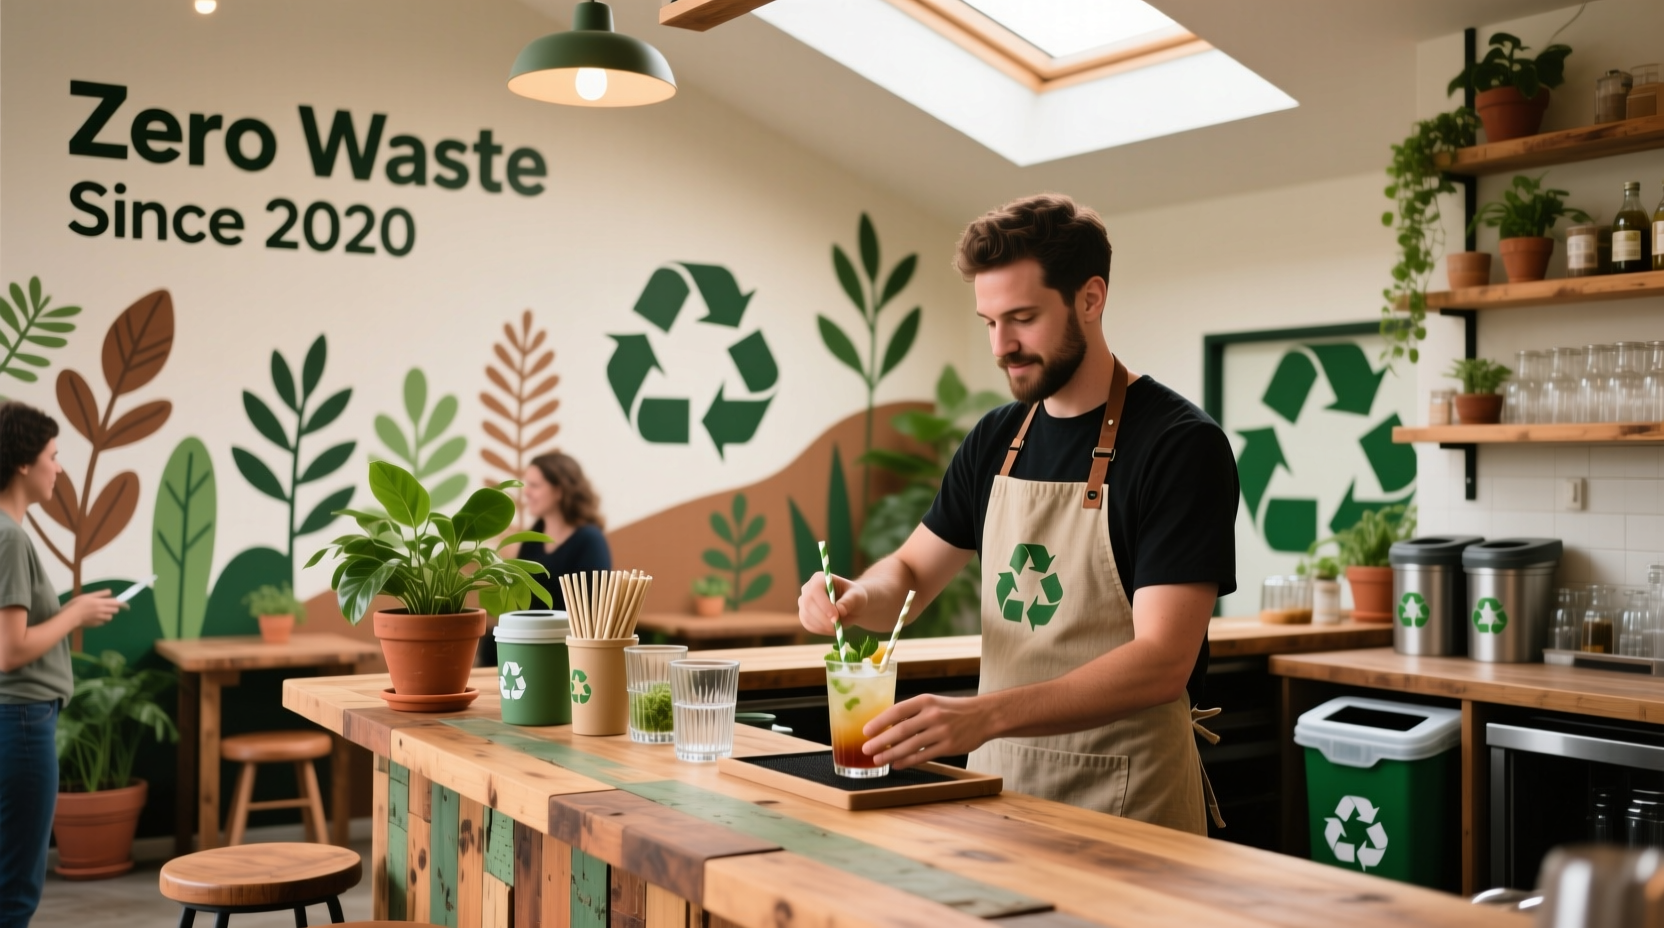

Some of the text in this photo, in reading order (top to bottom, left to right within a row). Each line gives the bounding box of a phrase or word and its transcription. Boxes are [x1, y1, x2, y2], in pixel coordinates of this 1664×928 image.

[68, 80, 548, 197] Zero Waste
[68, 181, 416, 257] Since 2020
